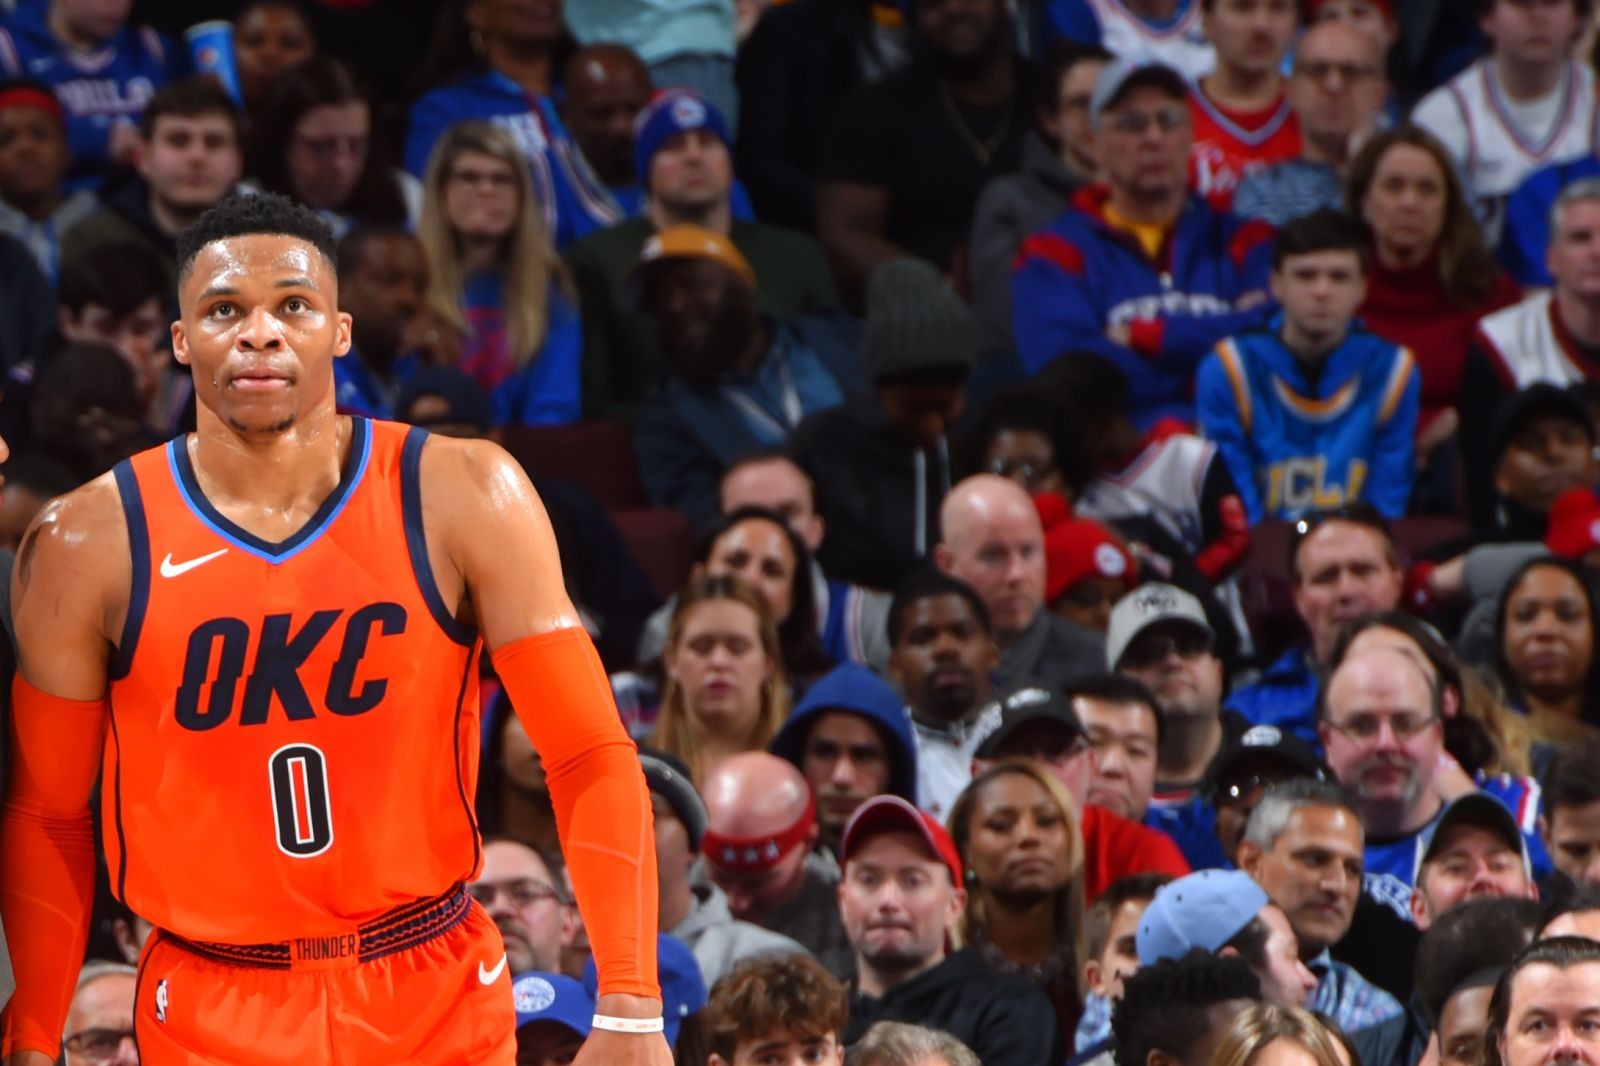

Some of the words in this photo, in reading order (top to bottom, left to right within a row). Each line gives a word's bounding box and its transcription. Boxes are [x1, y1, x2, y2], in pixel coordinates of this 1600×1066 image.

[174, 601, 408, 732] OKC
[267, 742, 335, 859] 0
[295, 934, 356, 961] THUNDER
